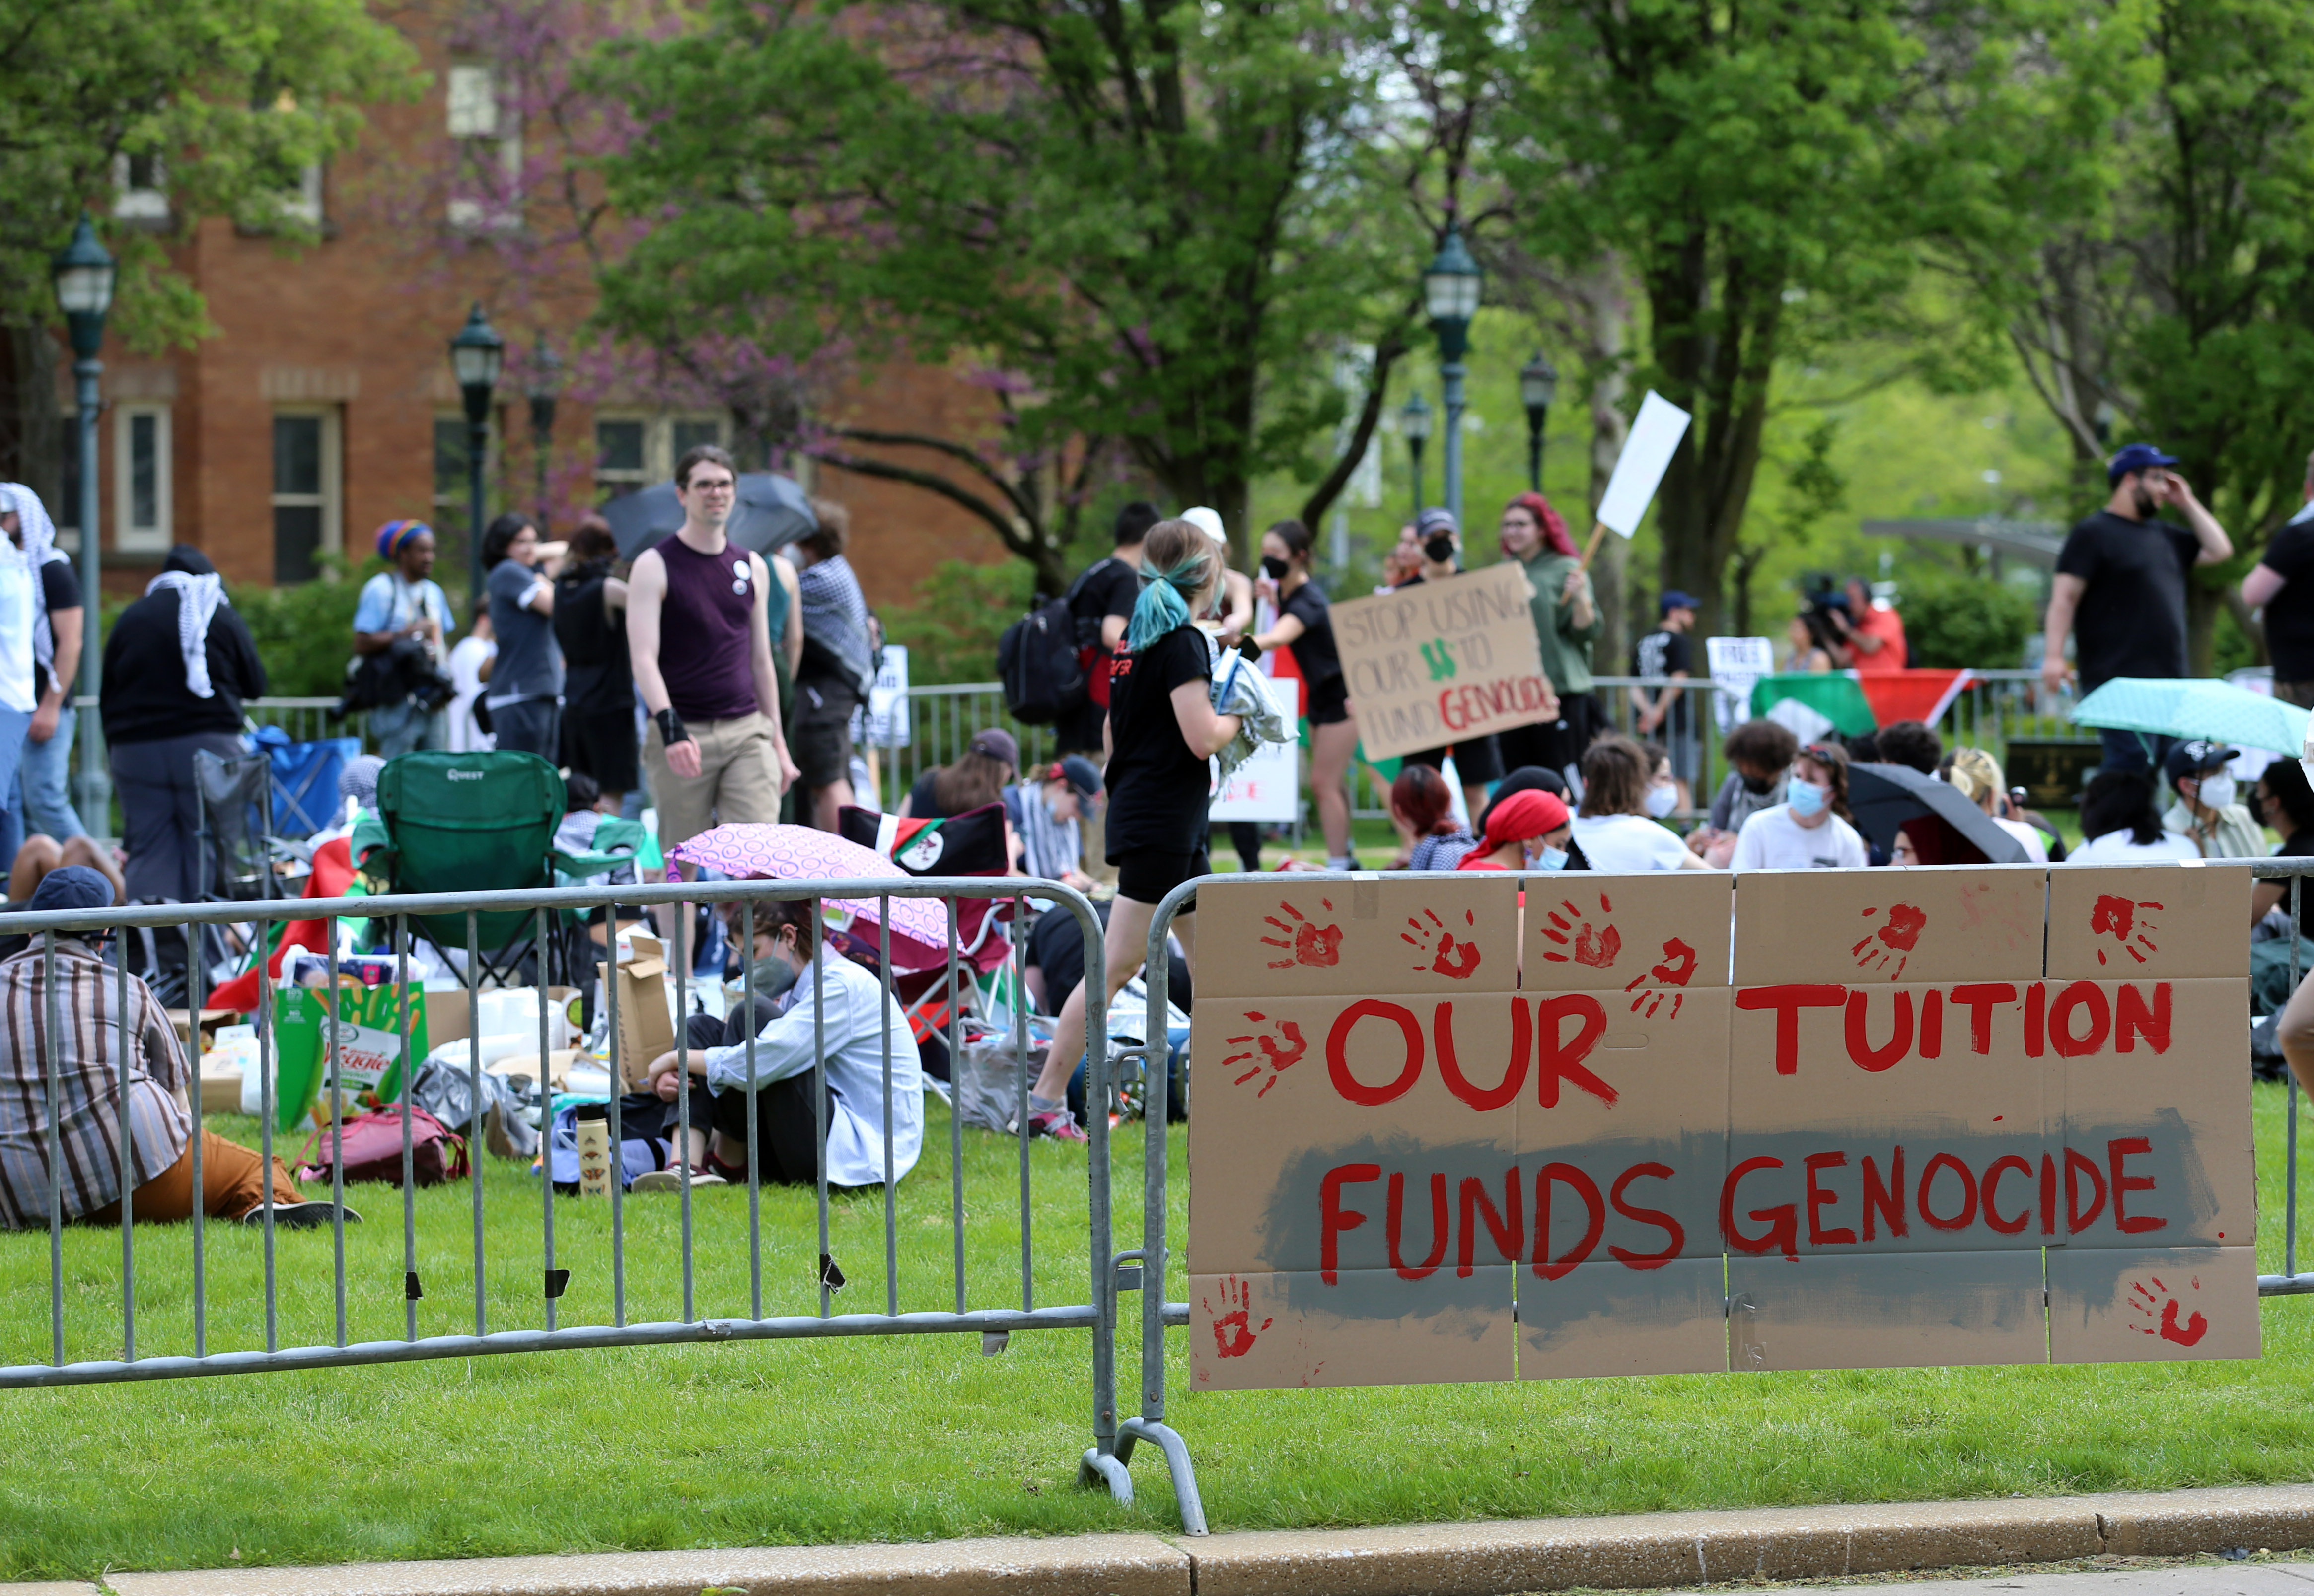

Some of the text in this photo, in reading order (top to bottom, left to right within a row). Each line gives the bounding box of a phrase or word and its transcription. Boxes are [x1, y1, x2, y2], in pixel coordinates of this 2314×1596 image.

[1343, 581, 1526, 648] STOP USING
[1351, 649, 1420, 699] OUR
[1457, 631, 1493, 673] TO
[1365, 675, 1554, 746] FUND GENOCIDE
[1325, 980, 2172, 1111] OUR TUITION
[1319, 1136, 2168, 1286] FUNDS GENOCIDE
